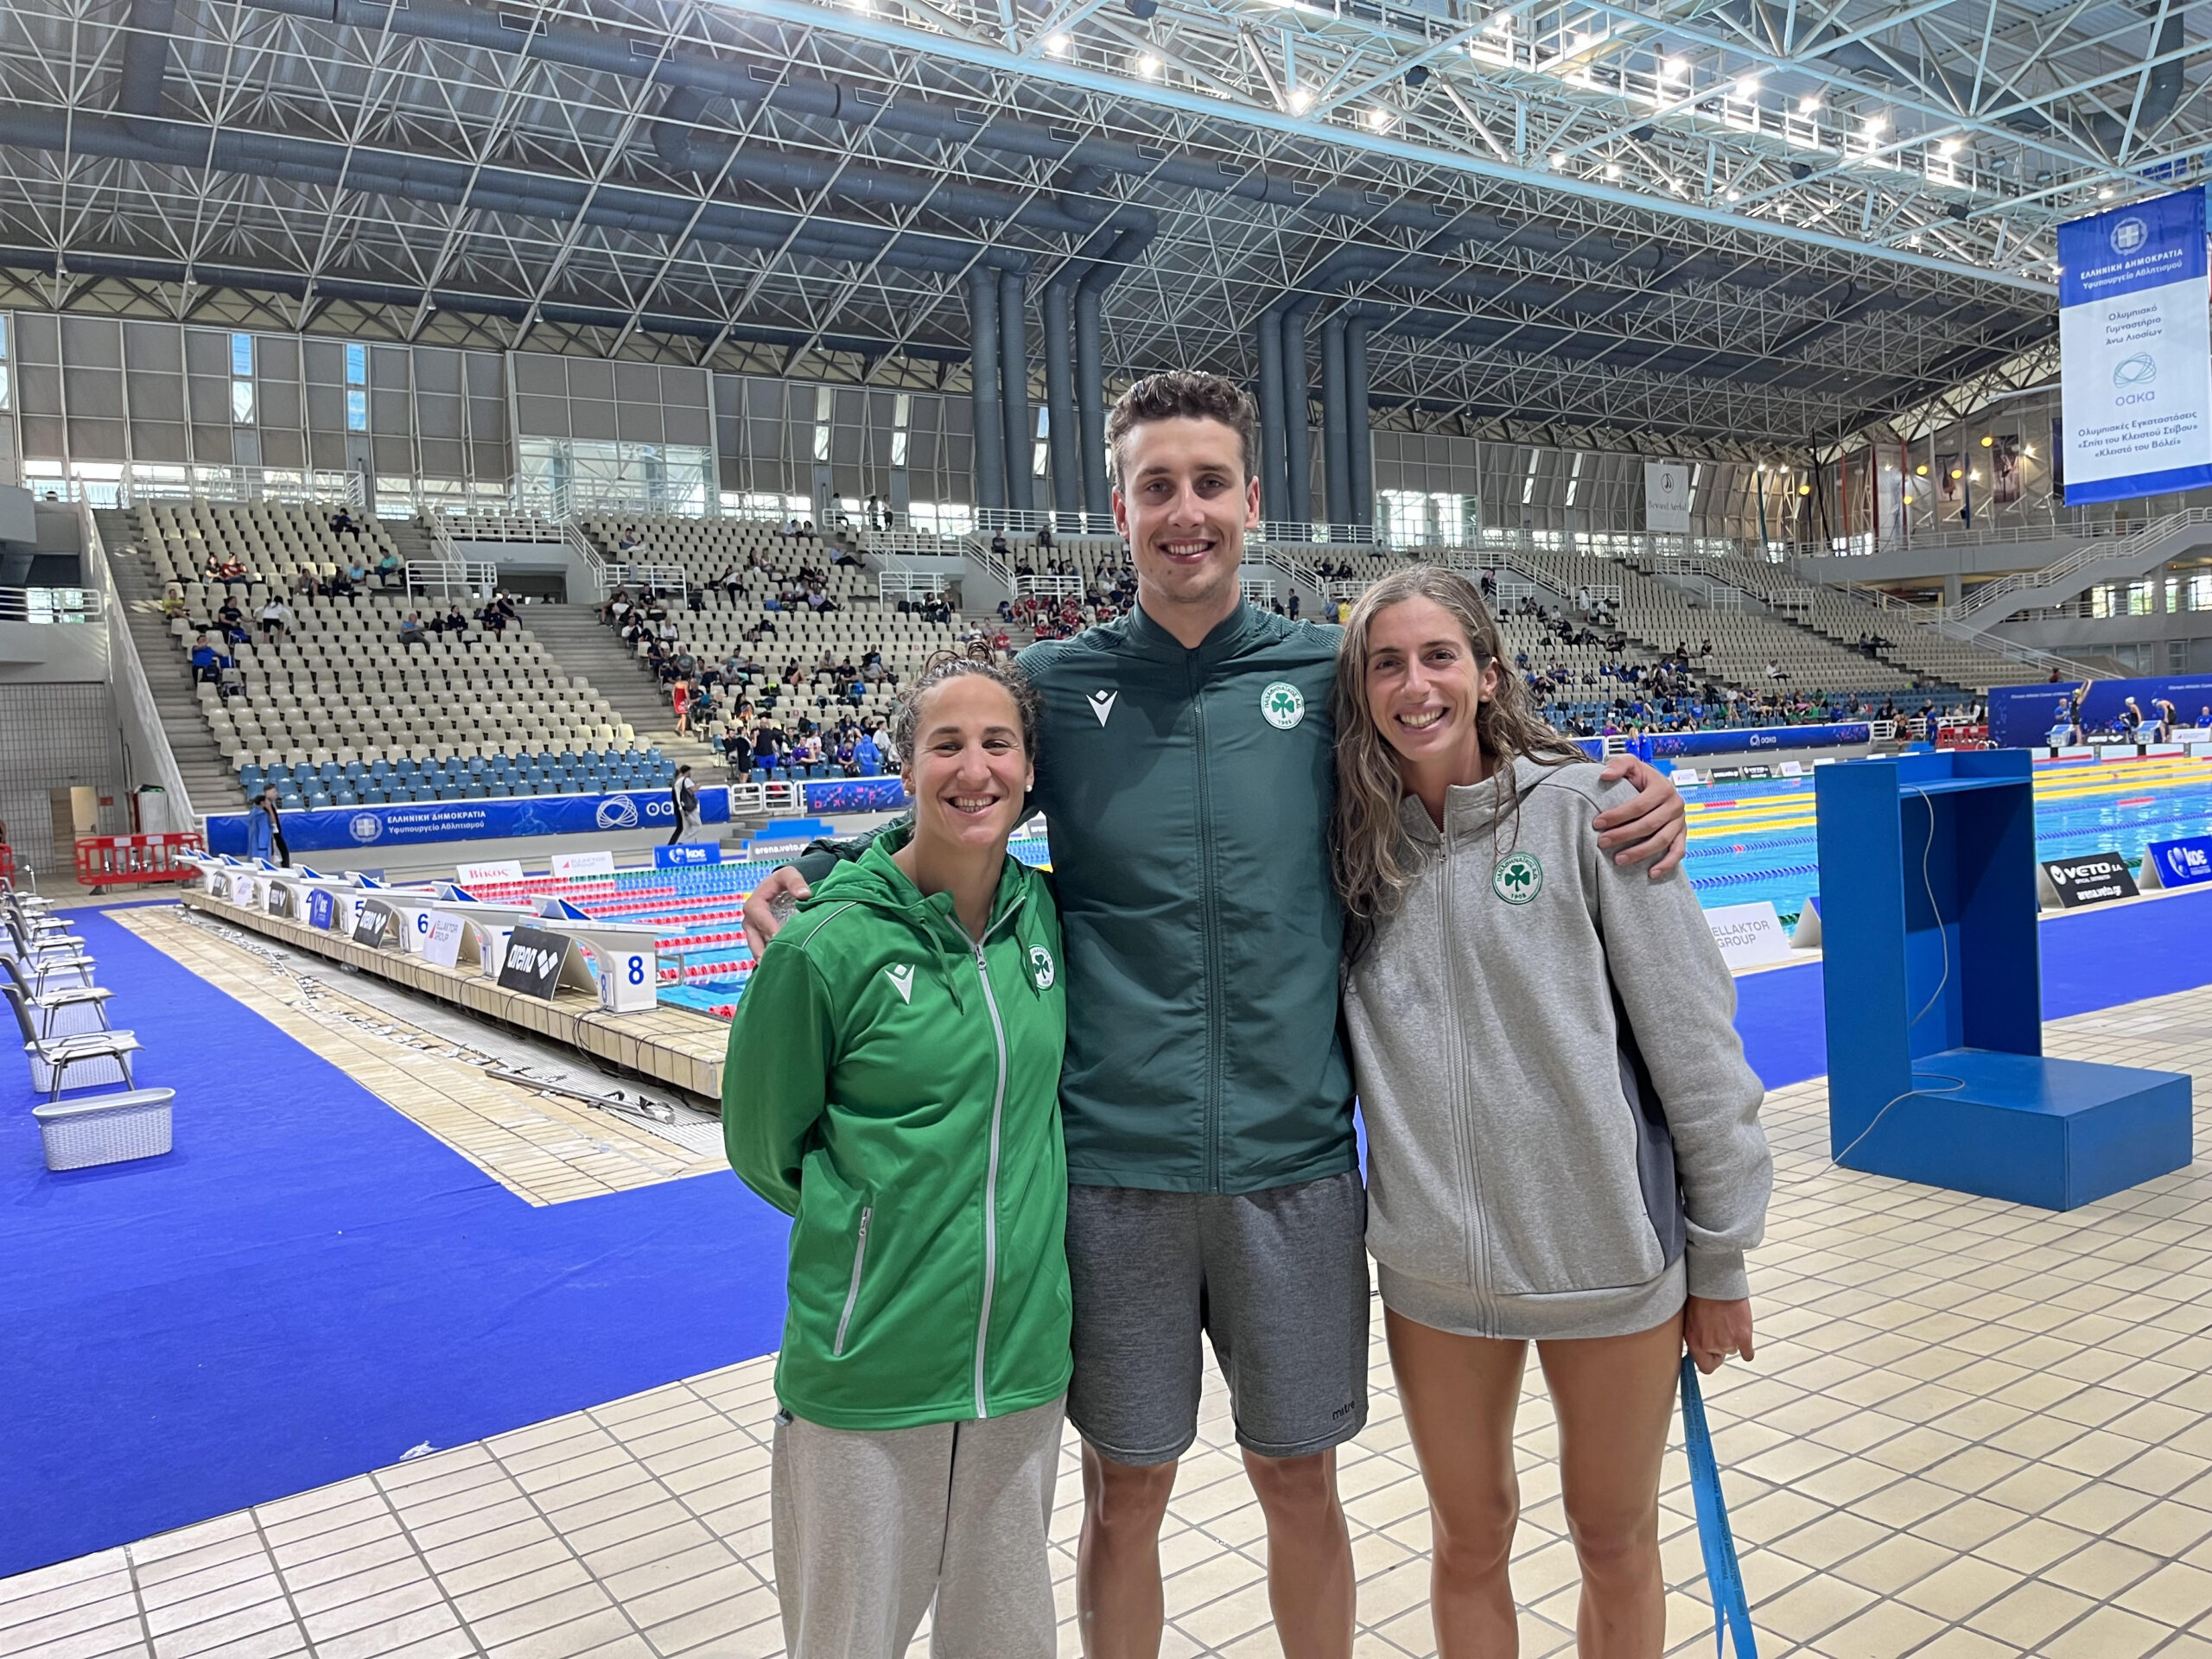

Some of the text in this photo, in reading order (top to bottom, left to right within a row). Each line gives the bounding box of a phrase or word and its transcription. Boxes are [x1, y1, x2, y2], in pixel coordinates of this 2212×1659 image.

[2081, 249, 2183, 280] ΕΛΛΗΝΙΚΗ ΔΗΜΟΚΡΑΤΙΑ
[2082, 260, 2183, 289] Υφυπουργείο Αθλητισμού
[2108, 304, 2158, 321] Ολυμπιακό
[2106, 317, 2162, 334] Γυμναστήριο
[2126, 329, 2163, 341] Λιοσίων
[2078, 411, 2197, 437] Ολυμπιακές Εγκαταστάσεις
[2105, 436, 2120, 445] του
[2122, 429, 2161, 442] Κλειστού
[2134, 442, 2150, 451] του
[387, 810, 486, 823] ΕΛΛΗΝΙΚΗ ΔΗΜΟΚΡΑΤΙΑ
[389, 820, 485, 835] Υφυπουργείο Αθλητισμού
[469, 867, 510, 879] Βίκος
[2063, 862, 2112, 879] VETO
[355, 900, 364, 918] 5
[417, 913, 429, 934] 6
[1711, 920, 1770, 937] ELLAKTOR
[1715, 934, 1757, 948] GROUP
[507, 944, 537, 973] arena
[628, 956, 644, 985] 8
[1332, 1400, 1355, 1421] mitre
